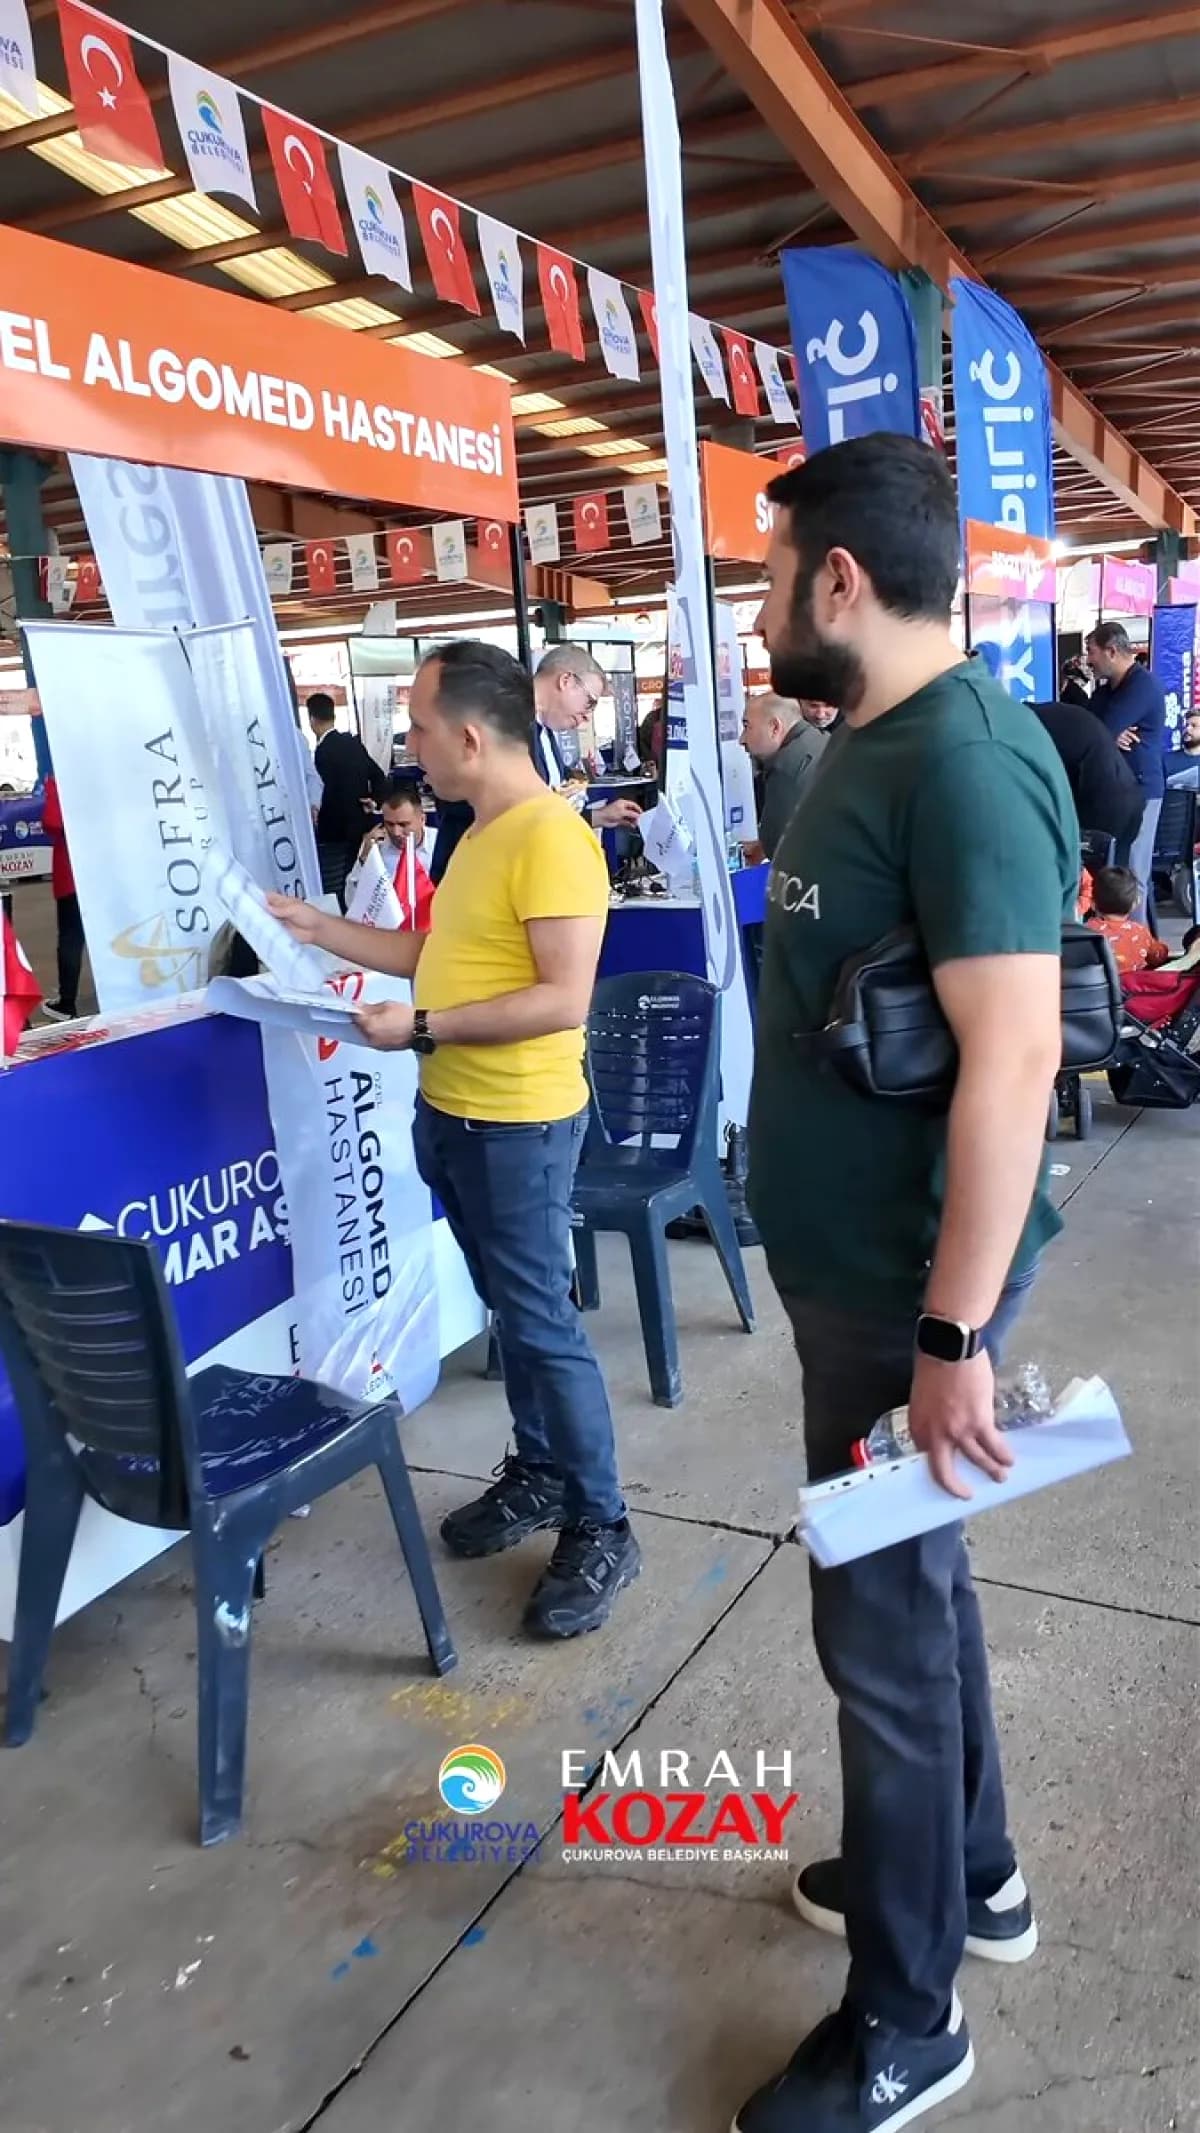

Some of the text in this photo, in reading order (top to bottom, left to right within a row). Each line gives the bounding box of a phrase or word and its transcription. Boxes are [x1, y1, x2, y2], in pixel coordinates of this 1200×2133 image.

[0, 310, 504, 477] EL ALGOMED HASTANESİ
[144, 726, 209, 935] SOFRA
[117, 1150, 283, 1240] ÇUKURO
[163, 1222, 241, 1287] MAR
[324, 1076, 370, 1316] HASTANESİ
[349, 1070, 392, 1300] ALGOMED
